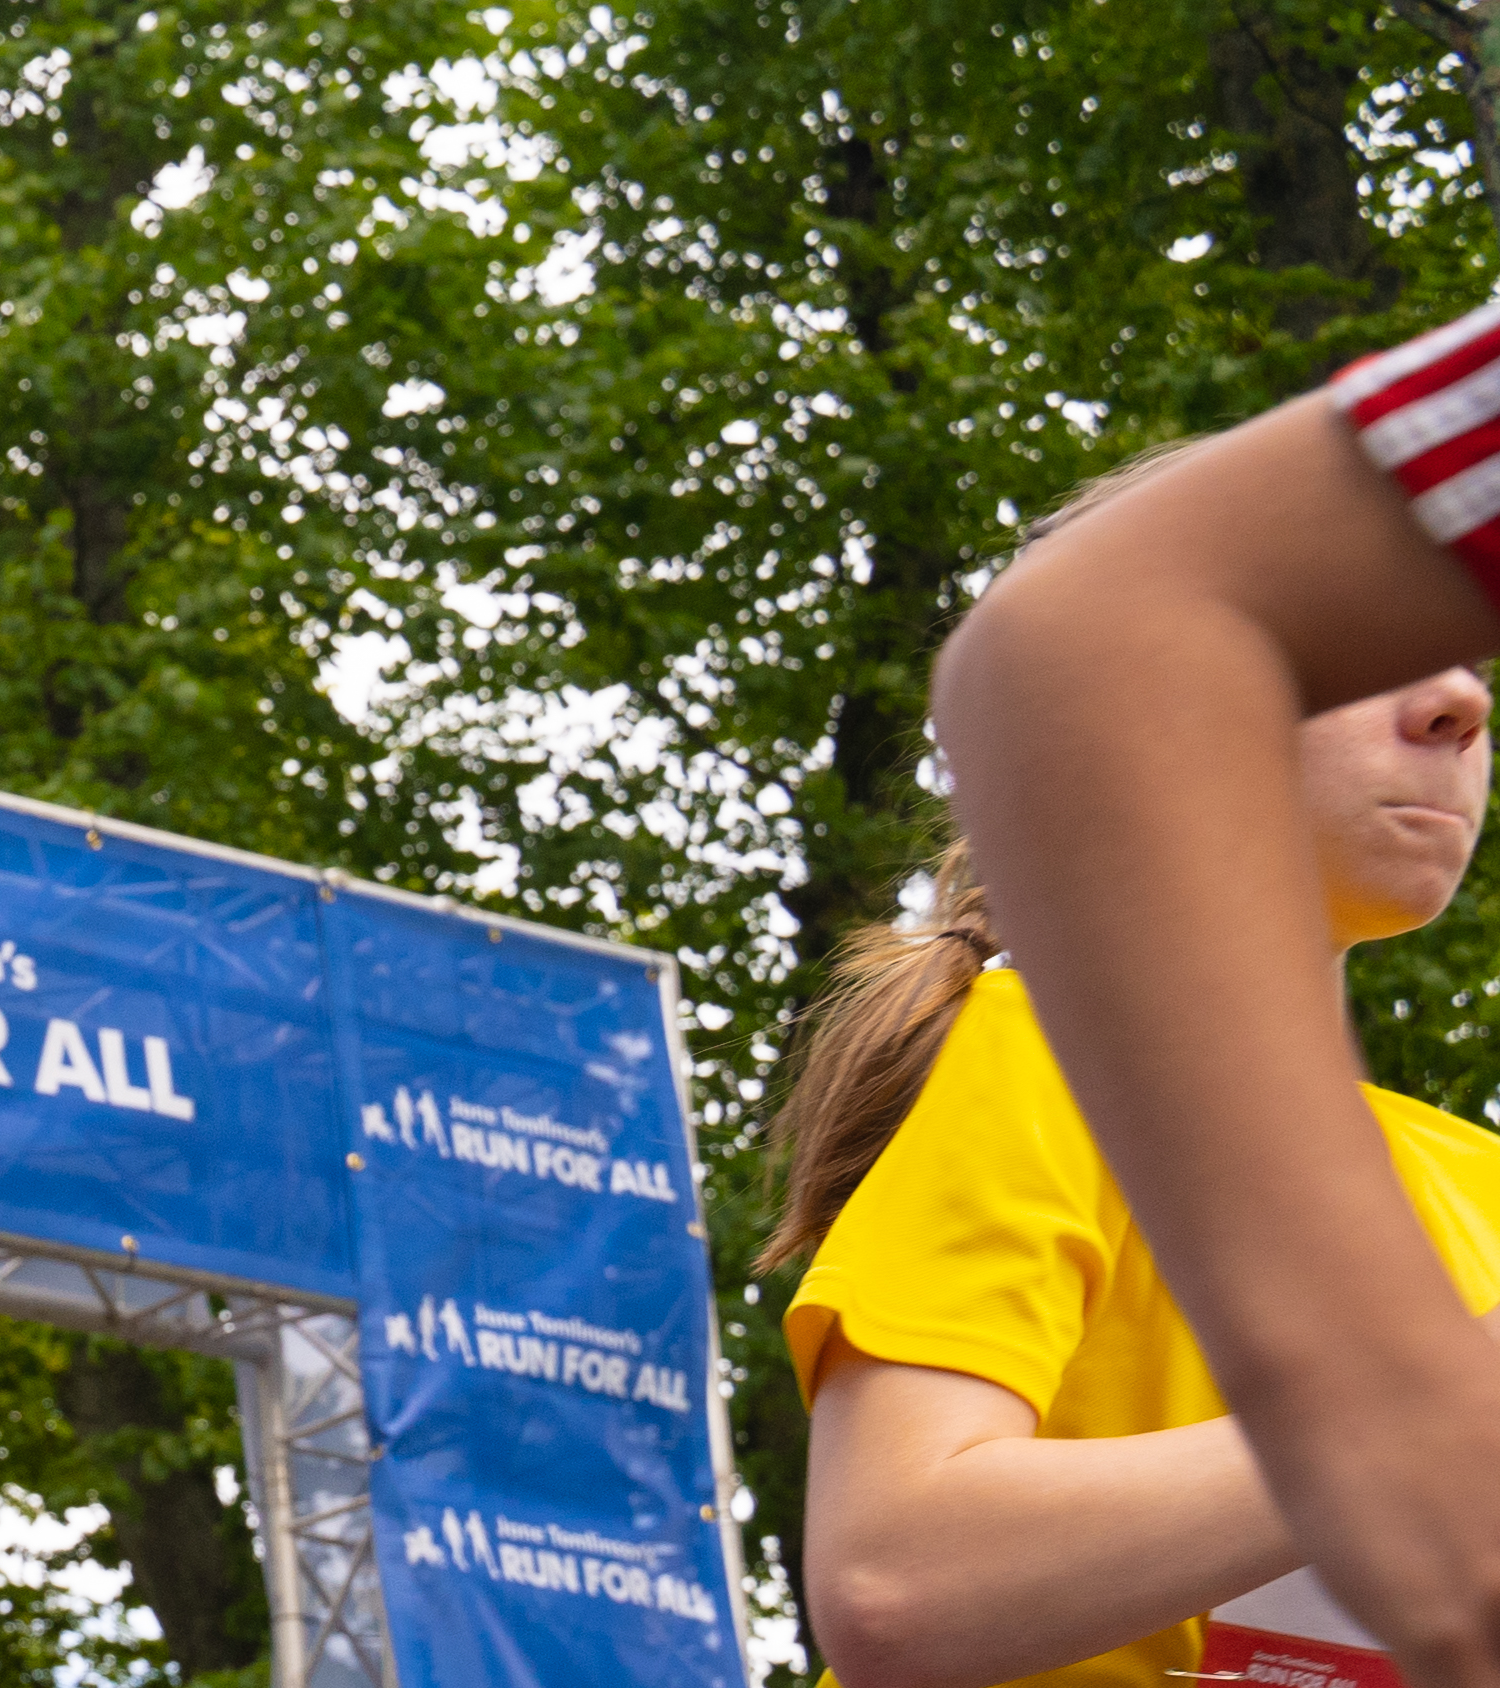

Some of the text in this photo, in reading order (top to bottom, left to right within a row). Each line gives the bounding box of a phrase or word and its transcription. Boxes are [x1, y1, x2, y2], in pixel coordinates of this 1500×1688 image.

[35, 1017, 195, 1122] ALL
[451, 1122, 677, 1202] RUN FOR ALL
[476, 1329, 690, 1413] RUN FOR ALL
[500, 1543, 716, 1623] RUN FOR ALL
[1246, 1662, 1289, 1685] RUN
